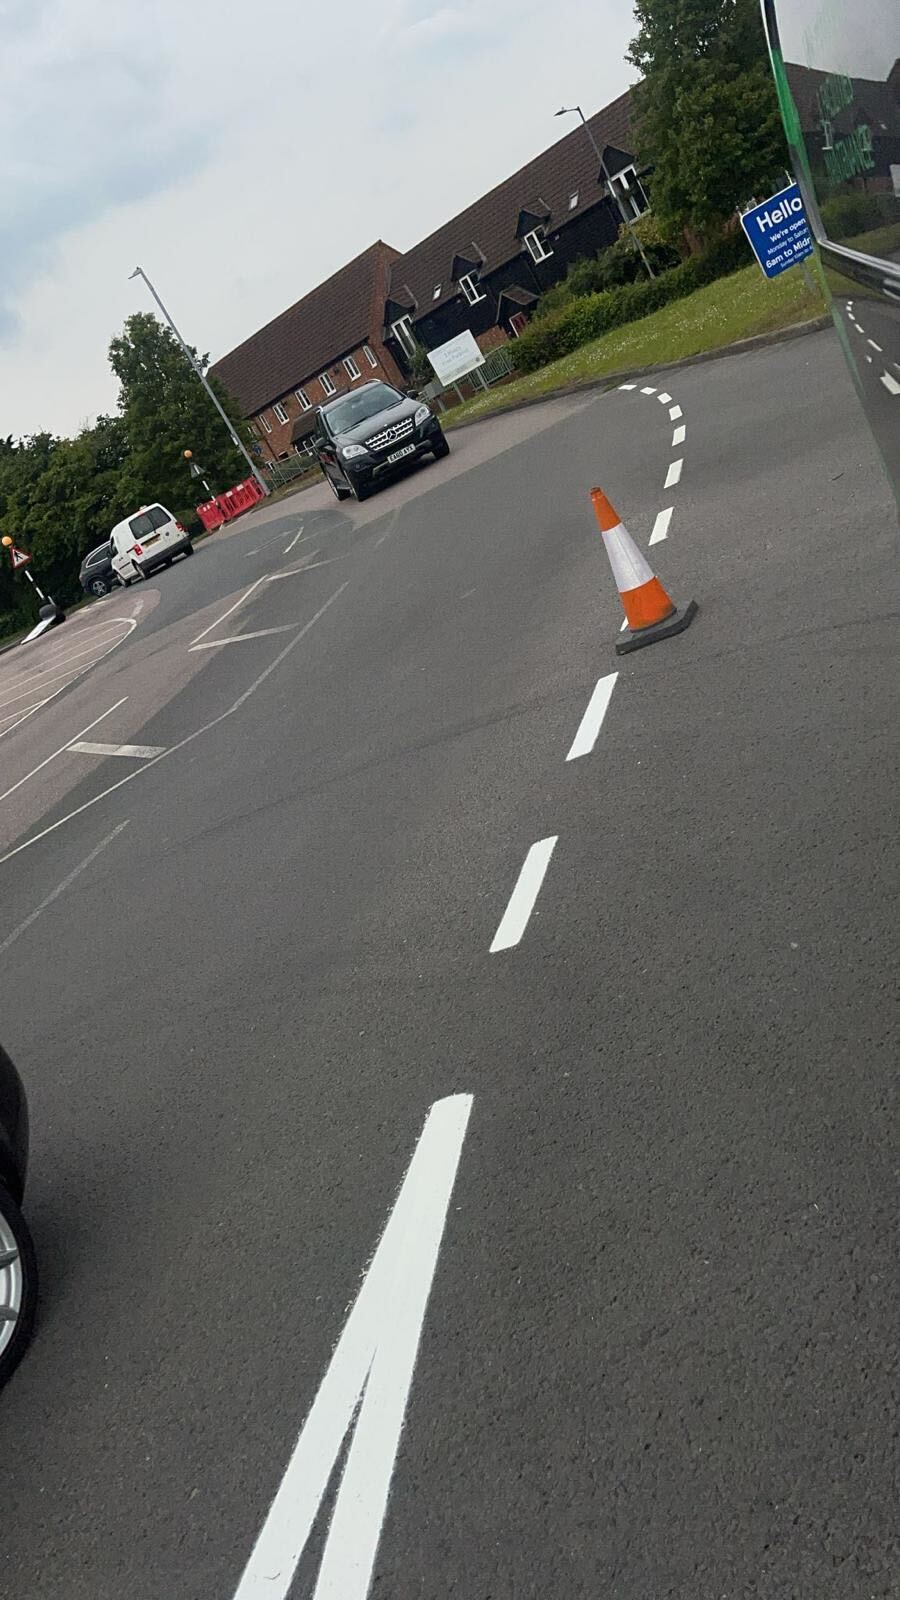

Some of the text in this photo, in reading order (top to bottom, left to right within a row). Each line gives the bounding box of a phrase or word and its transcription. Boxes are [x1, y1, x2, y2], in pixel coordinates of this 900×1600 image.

[756, 198, 802, 232] Hello
[767, 240, 788, 255] Monday
[794, 227, 809, 239] Satur
[770, 218, 806, 242] We're open
[766, 254, 784, 268] 6am
[783, 249, 793, 258] to
